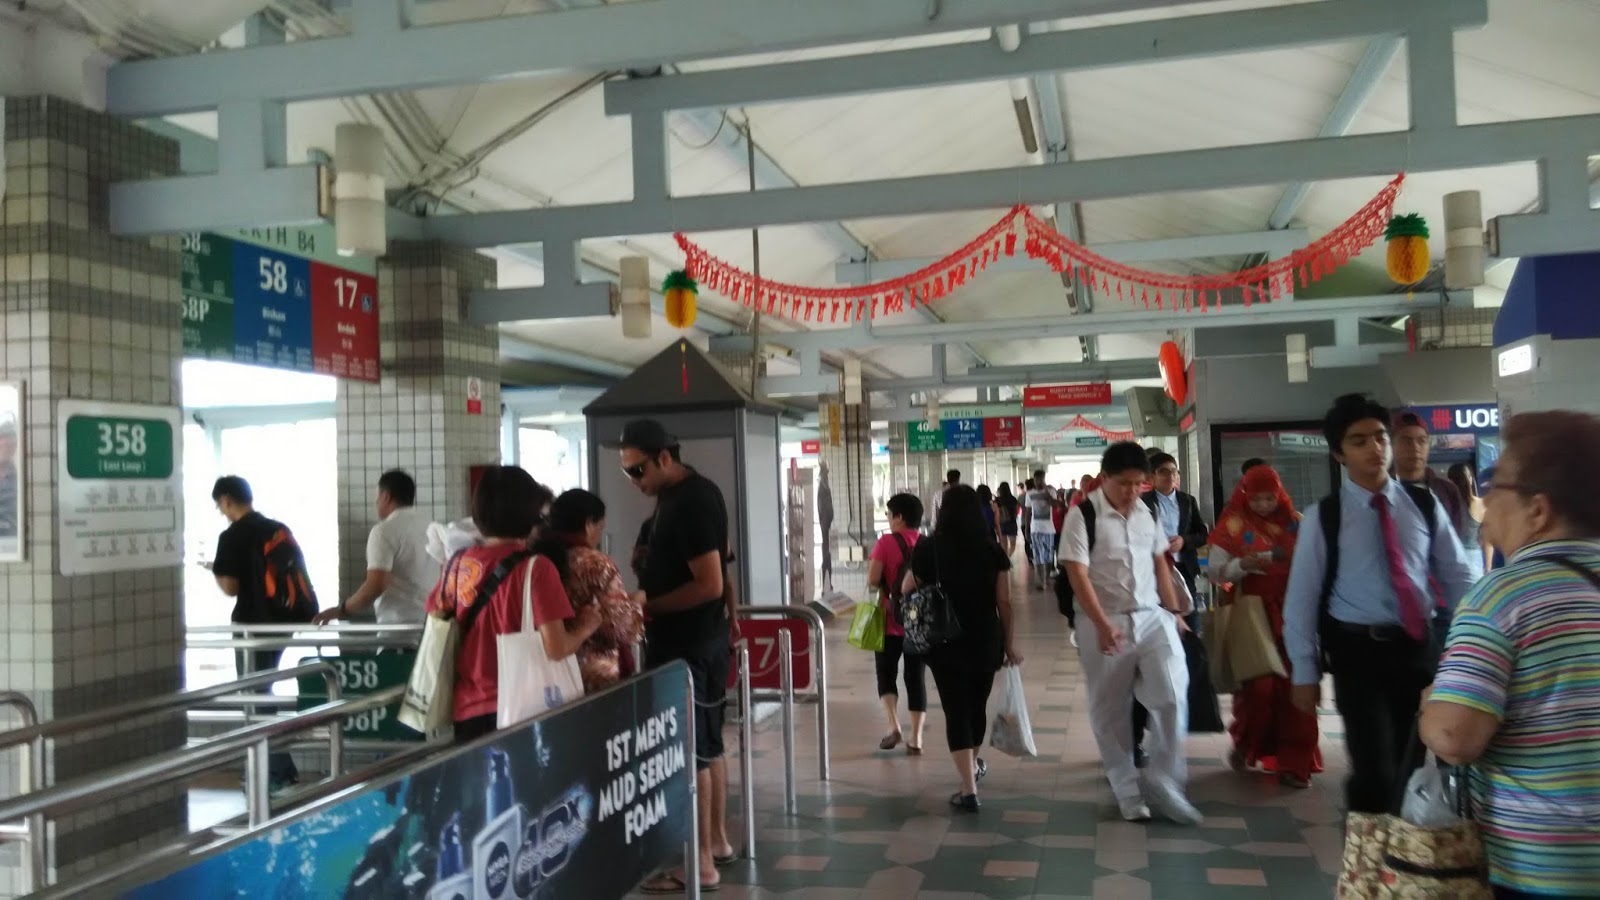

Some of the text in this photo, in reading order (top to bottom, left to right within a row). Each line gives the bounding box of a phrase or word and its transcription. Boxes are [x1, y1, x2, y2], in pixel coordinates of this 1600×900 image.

[259, 257, 288, 294] 58
[334, 276, 358, 309] 17
[97, 422, 147, 457] 358
[958, 419, 971, 431] 12
[606, 706, 677, 771] 1ST MEN'S
[598, 740, 686, 822] MUD SERUM
[624, 789, 668, 844] FOAM
